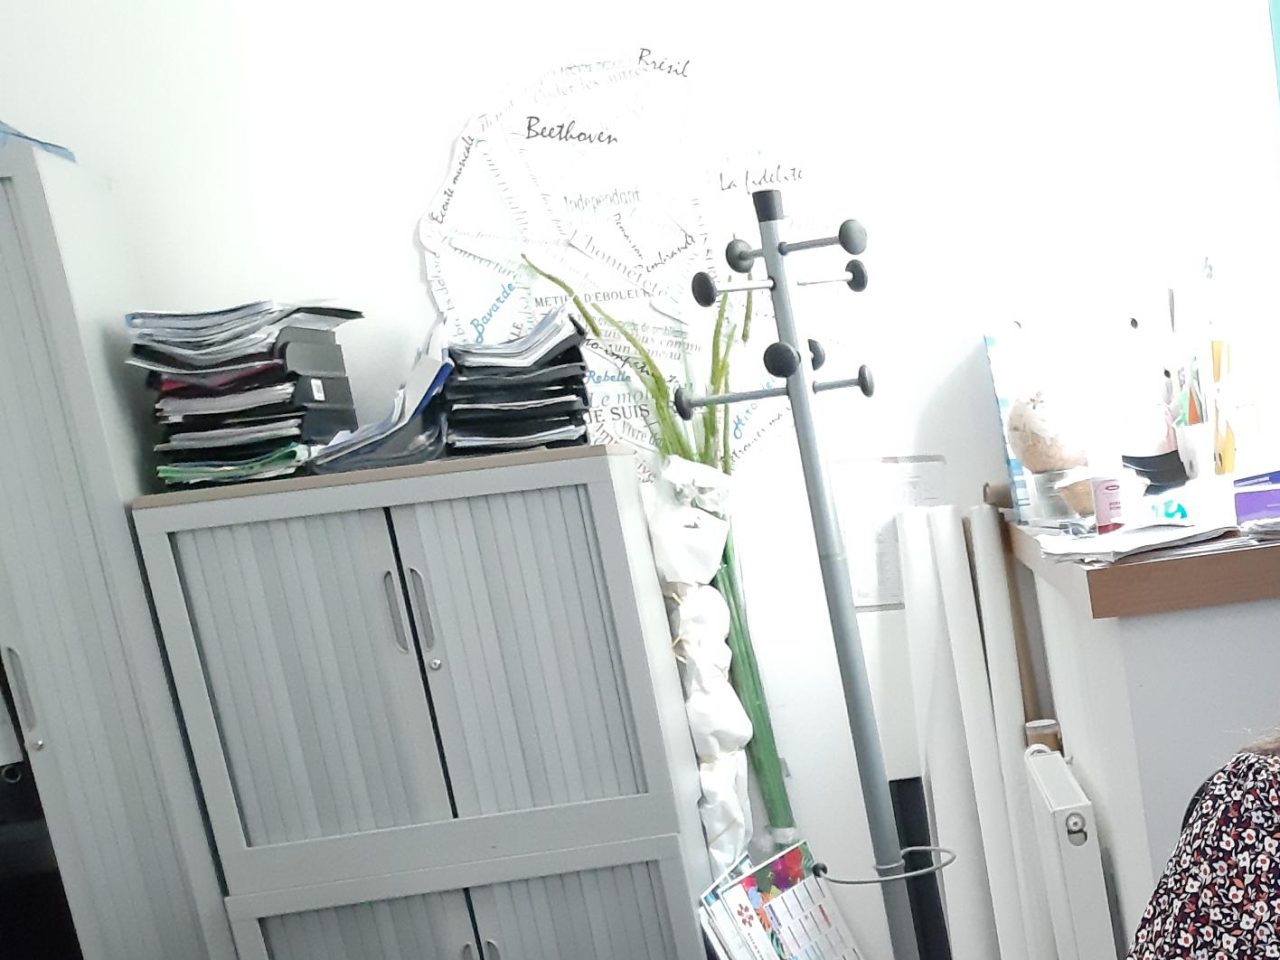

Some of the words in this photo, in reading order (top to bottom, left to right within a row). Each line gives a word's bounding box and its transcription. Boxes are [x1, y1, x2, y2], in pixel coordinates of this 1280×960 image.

[525, 116, 619, 145] Beethoven
[470, 282, 517, 344] Bavarde
[583, 369, 632, 385] Rebelle
[610, 403, 650, 422] SUIS
